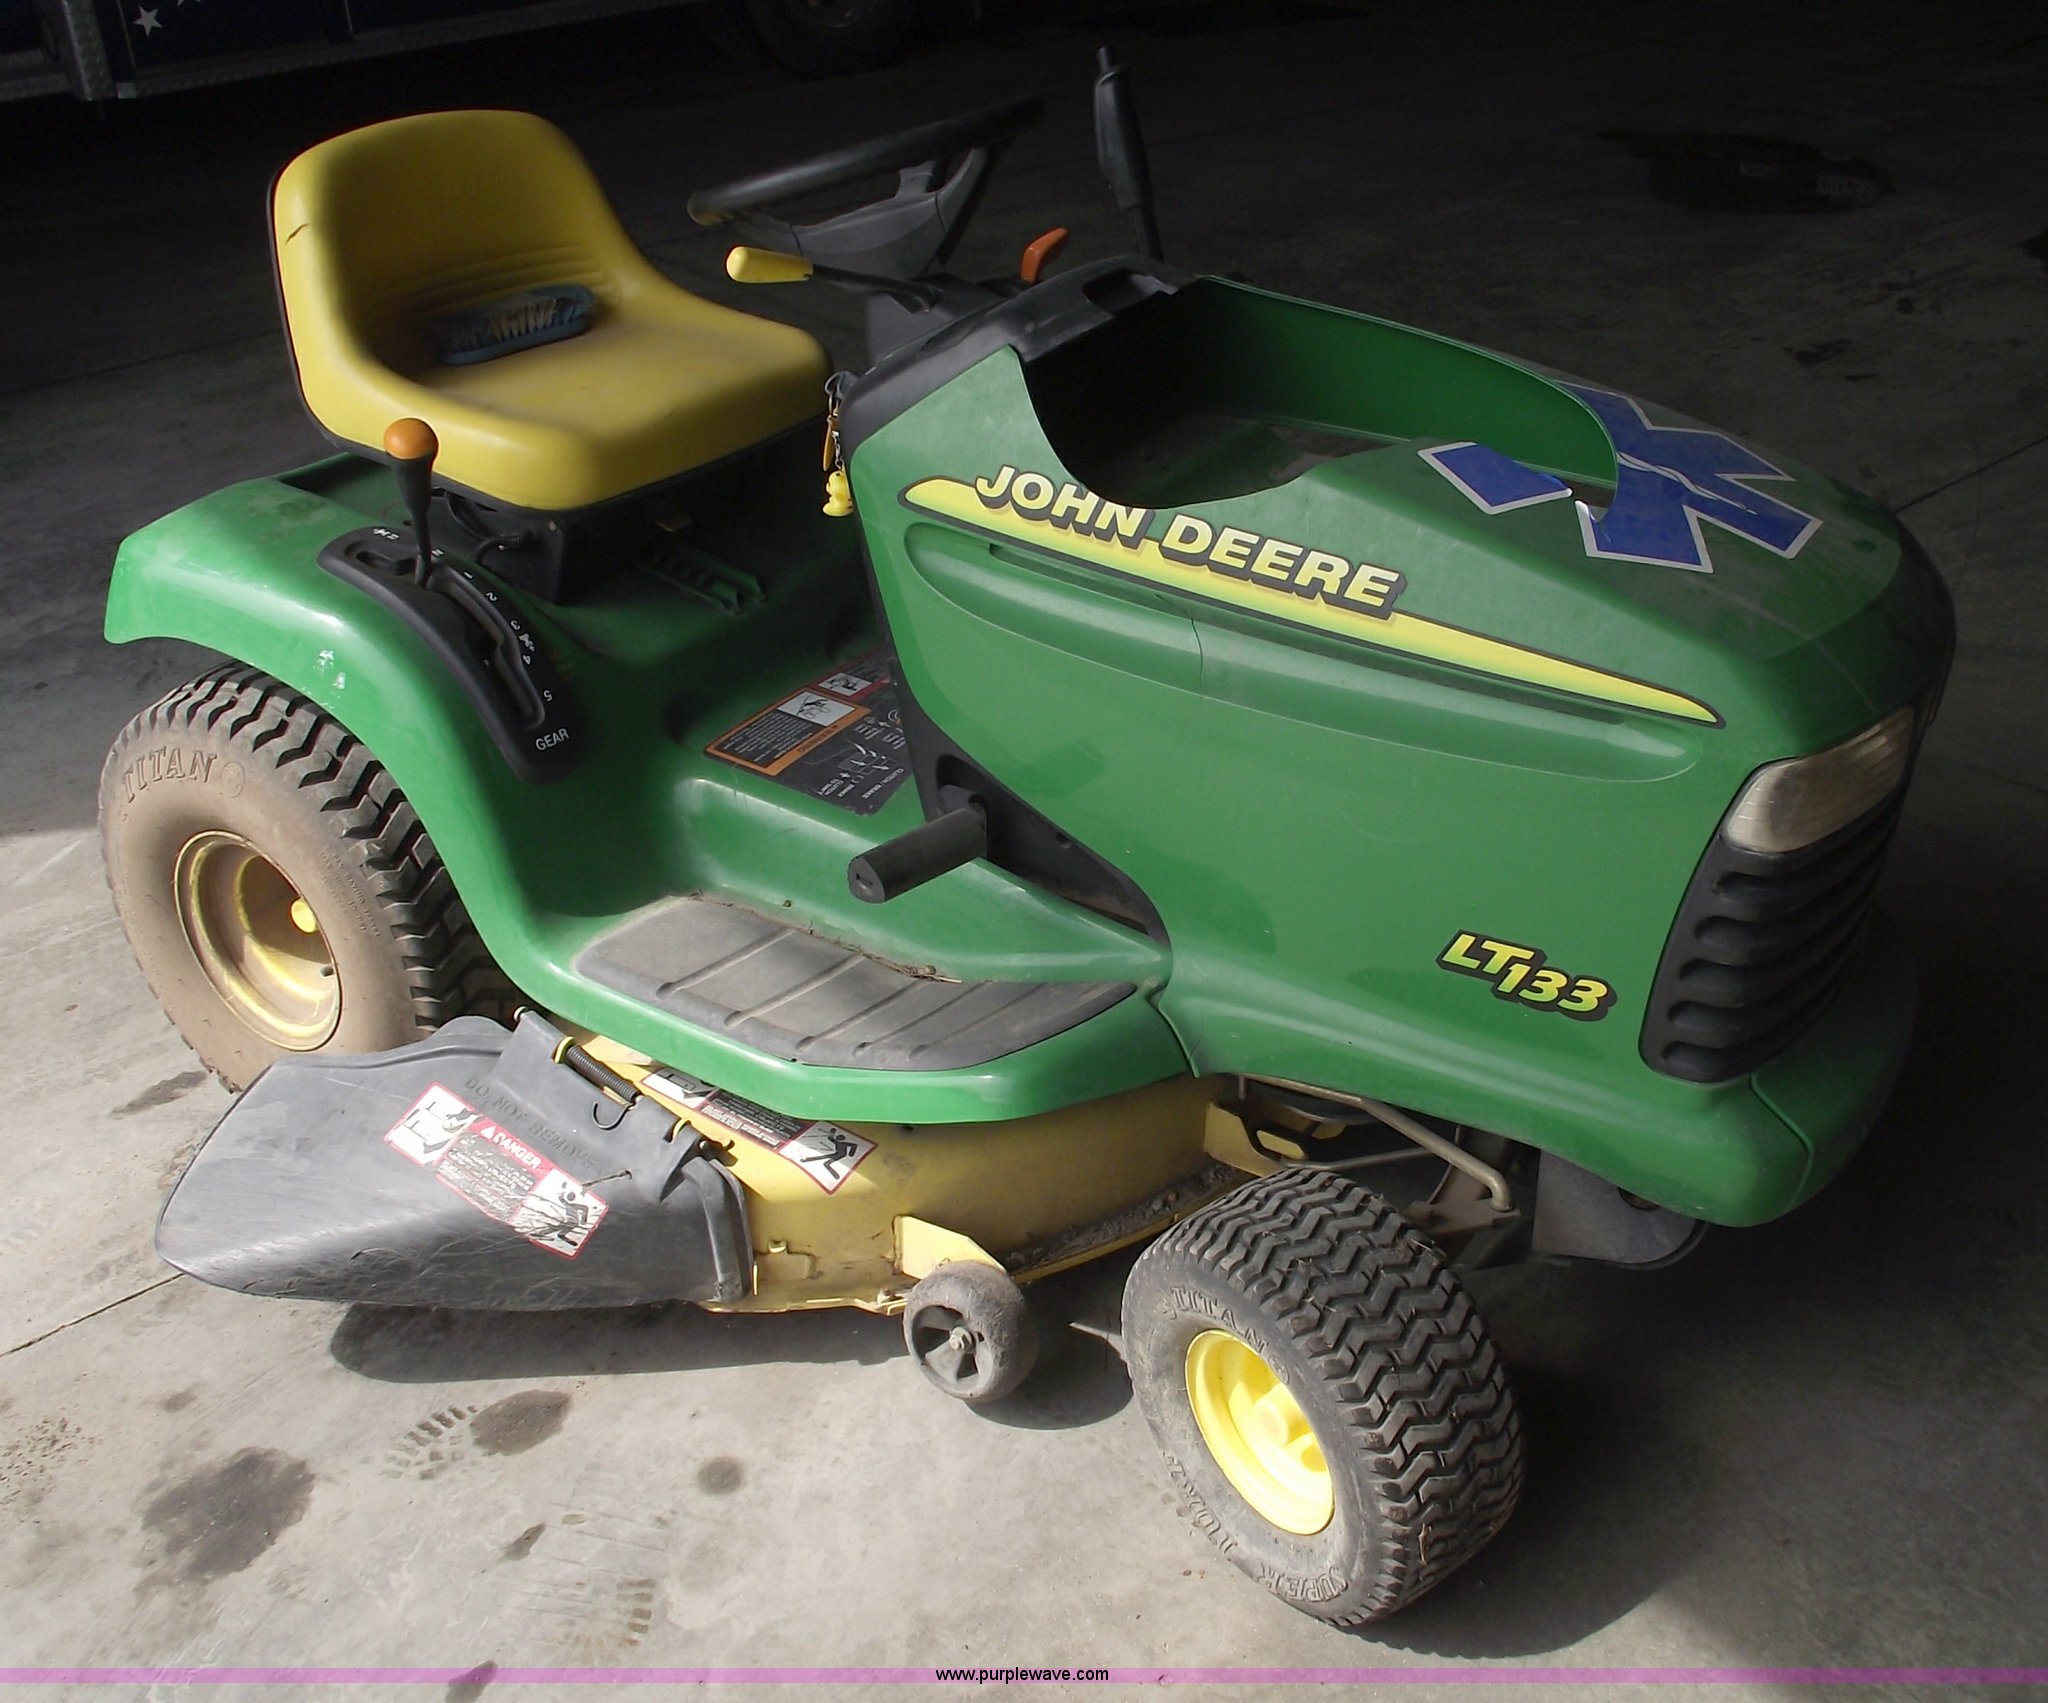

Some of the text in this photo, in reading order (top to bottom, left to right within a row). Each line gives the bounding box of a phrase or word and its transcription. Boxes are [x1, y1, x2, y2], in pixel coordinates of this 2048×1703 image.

[974, 464, 1407, 621] JOHN DEERE
[485, 592, 498, 602] 2
[510, 620, 521, 631] 3
[521, 654, 532, 666] 4
[543, 690, 553, 702] 5
[534, 727, 570, 752] GEAR
[122, 746, 218, 804] TITAN
[1438, 931, 1614, 1019] LT133
[465, 1077, 598, 1169] DO NOT REMOVE
[493, 1131, 542, 1170] DANGER
[1171, 1286, 1270, 1354] TITAN
[1257, 1563, 1349, 1603] SUPER
